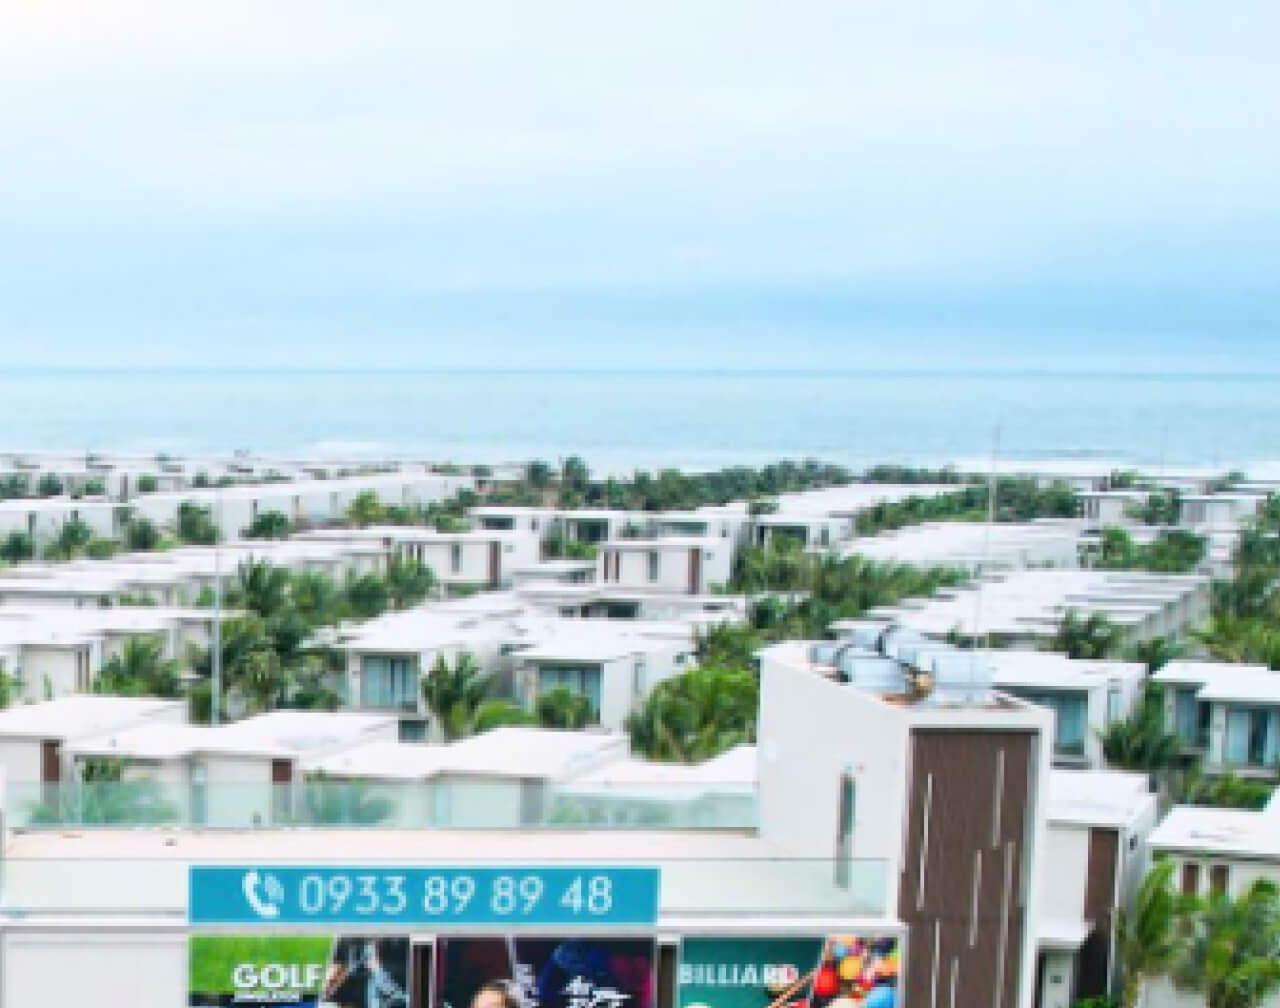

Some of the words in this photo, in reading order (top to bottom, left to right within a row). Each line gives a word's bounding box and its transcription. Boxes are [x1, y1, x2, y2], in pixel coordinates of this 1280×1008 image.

[299, 875, 407, 914] 0933
[423, 875, 476, 914] 89
[491, 875, 544, 914] 89
[559, 875, 613, 914] 48
[232, 962, 324, 988] GOLF
[679, 963, 798, 985] BILLIARD
